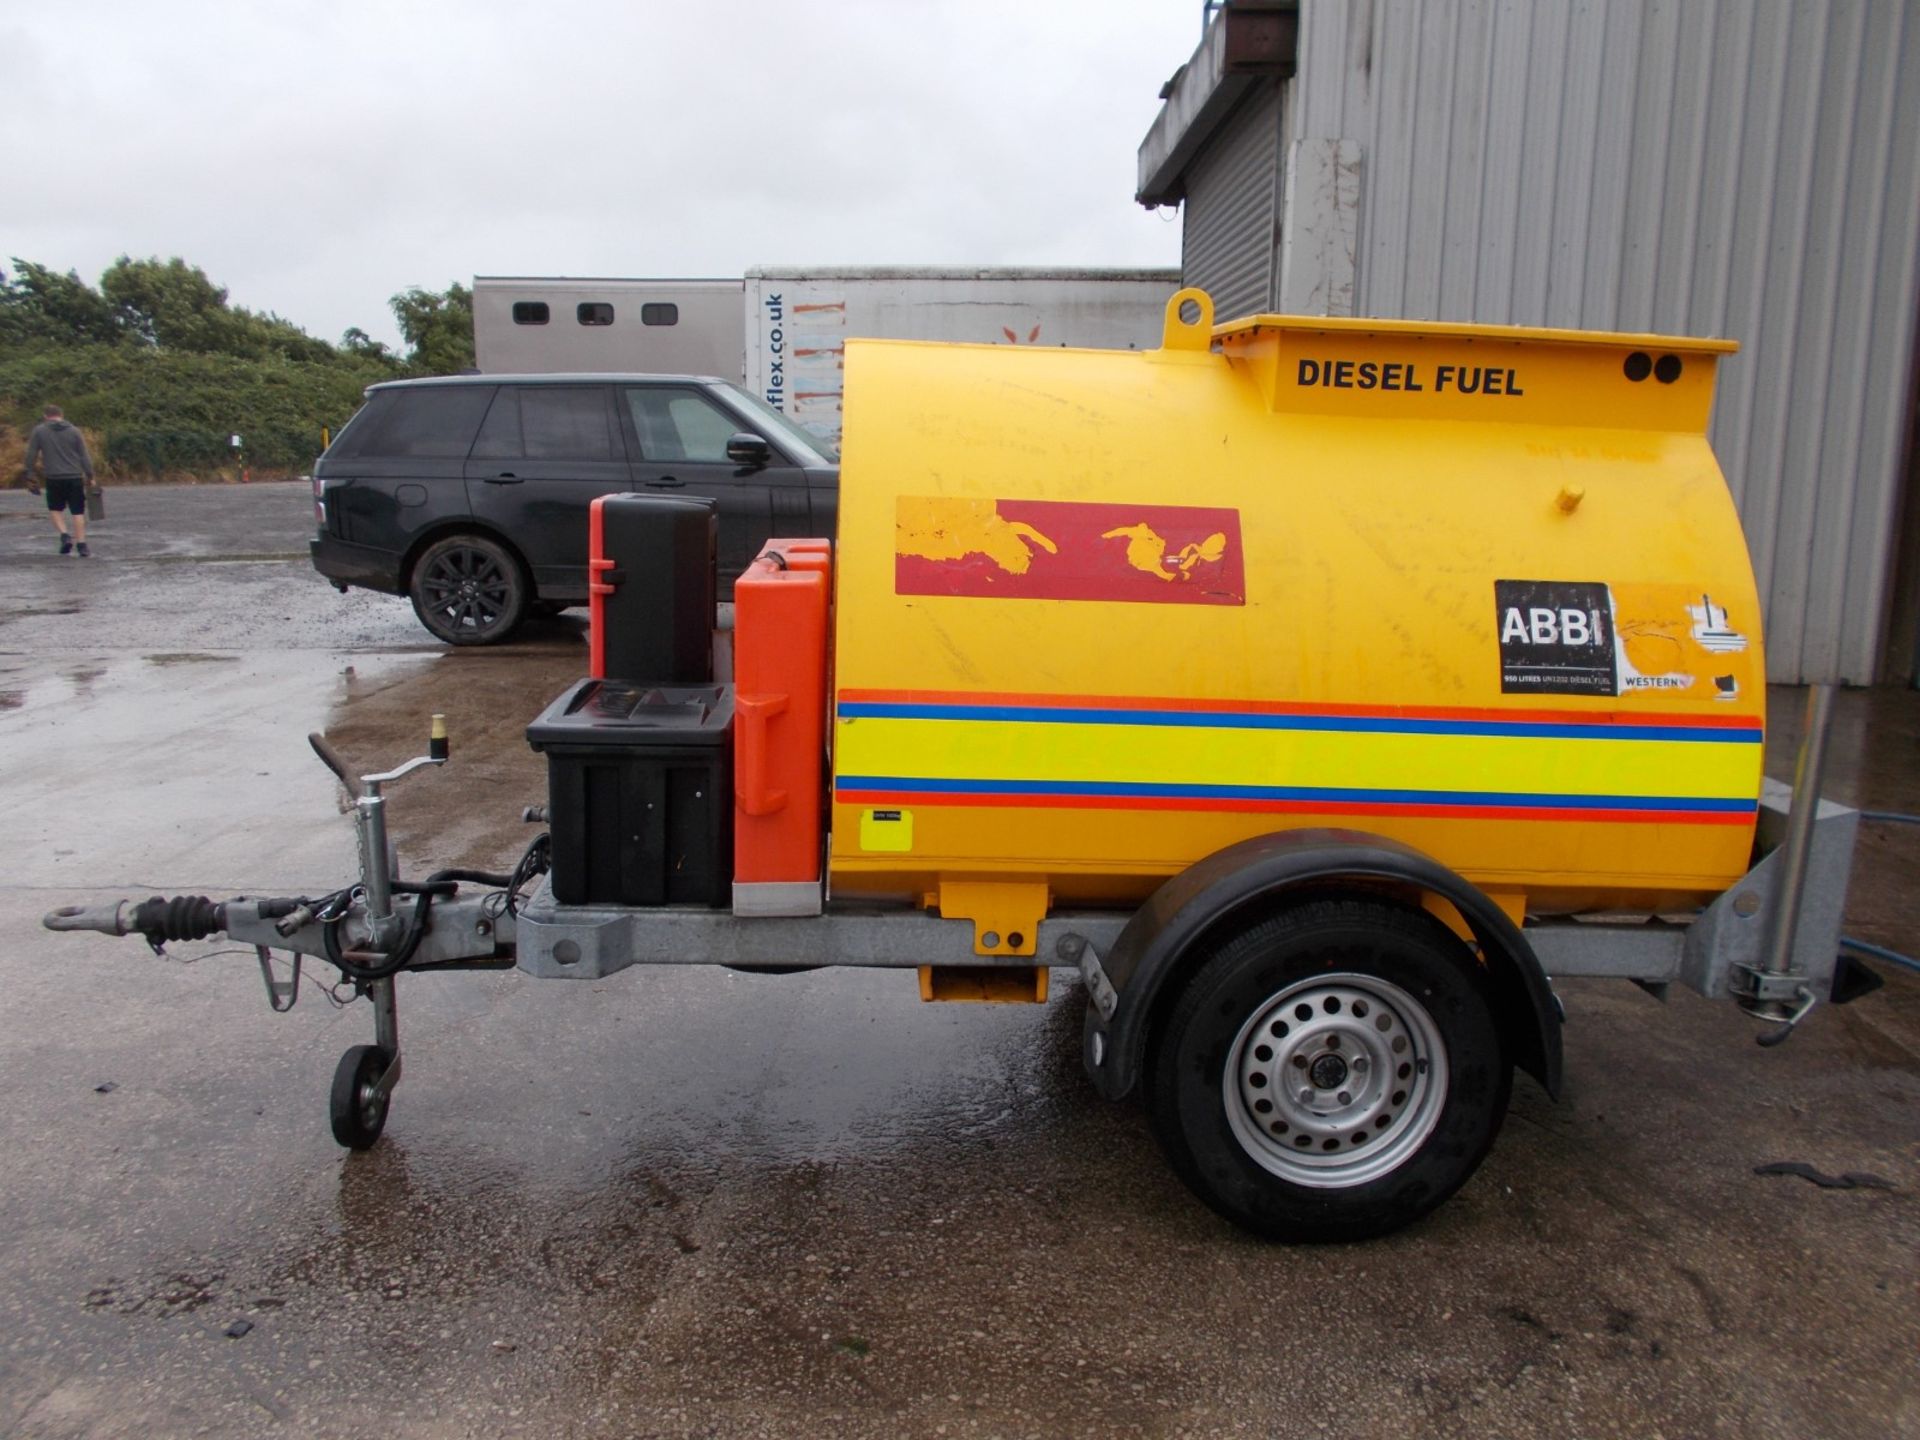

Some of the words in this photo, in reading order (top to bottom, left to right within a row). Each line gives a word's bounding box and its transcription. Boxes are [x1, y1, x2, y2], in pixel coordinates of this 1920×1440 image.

[1297, 359, 1423, 392] DIESEL
[1435, 366, 1524, 396] FUEL
[1501, 607, 1604, 646] ABBI
[1518, 675, 1542, 683] LITRES
[1570, 676, 1592, 684] DIESEL
[1625, 676, 1680, 688] WESTERN
